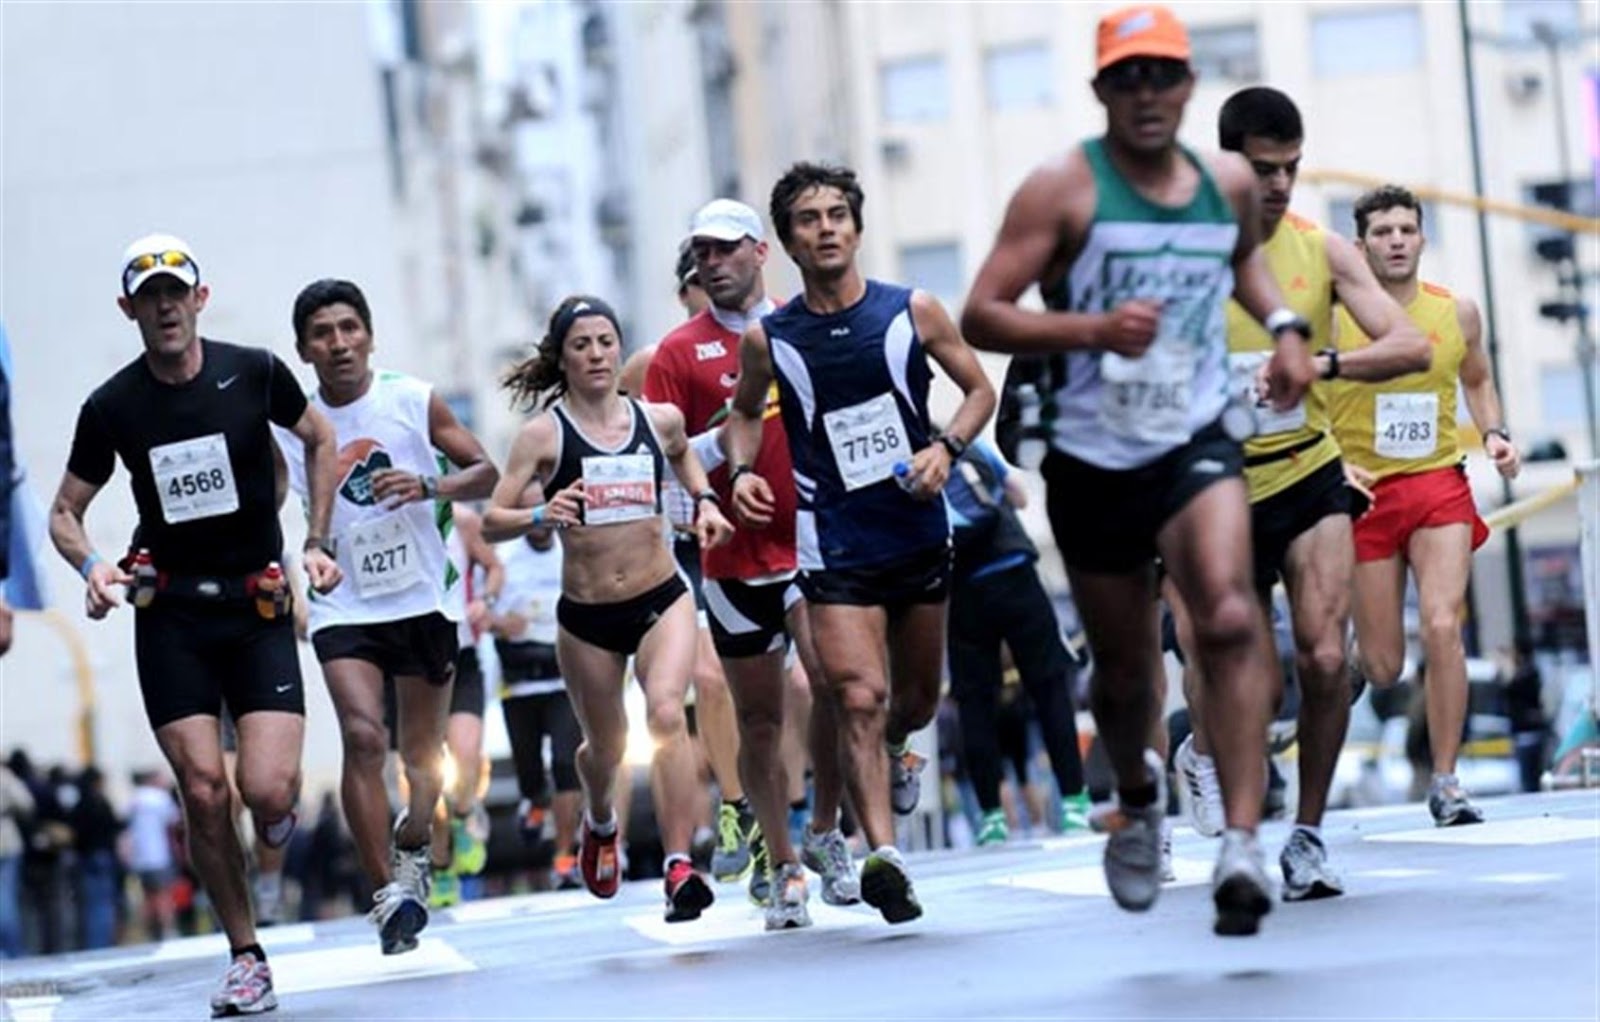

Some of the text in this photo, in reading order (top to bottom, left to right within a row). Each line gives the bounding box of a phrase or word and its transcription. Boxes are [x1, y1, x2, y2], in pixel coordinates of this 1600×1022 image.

[842, 426, 900, 463] 7758
[1384, 421, 1431, 441] 4783
[168, 468, 225, 498] 4568
[361, 543, 407, 574] 4277
